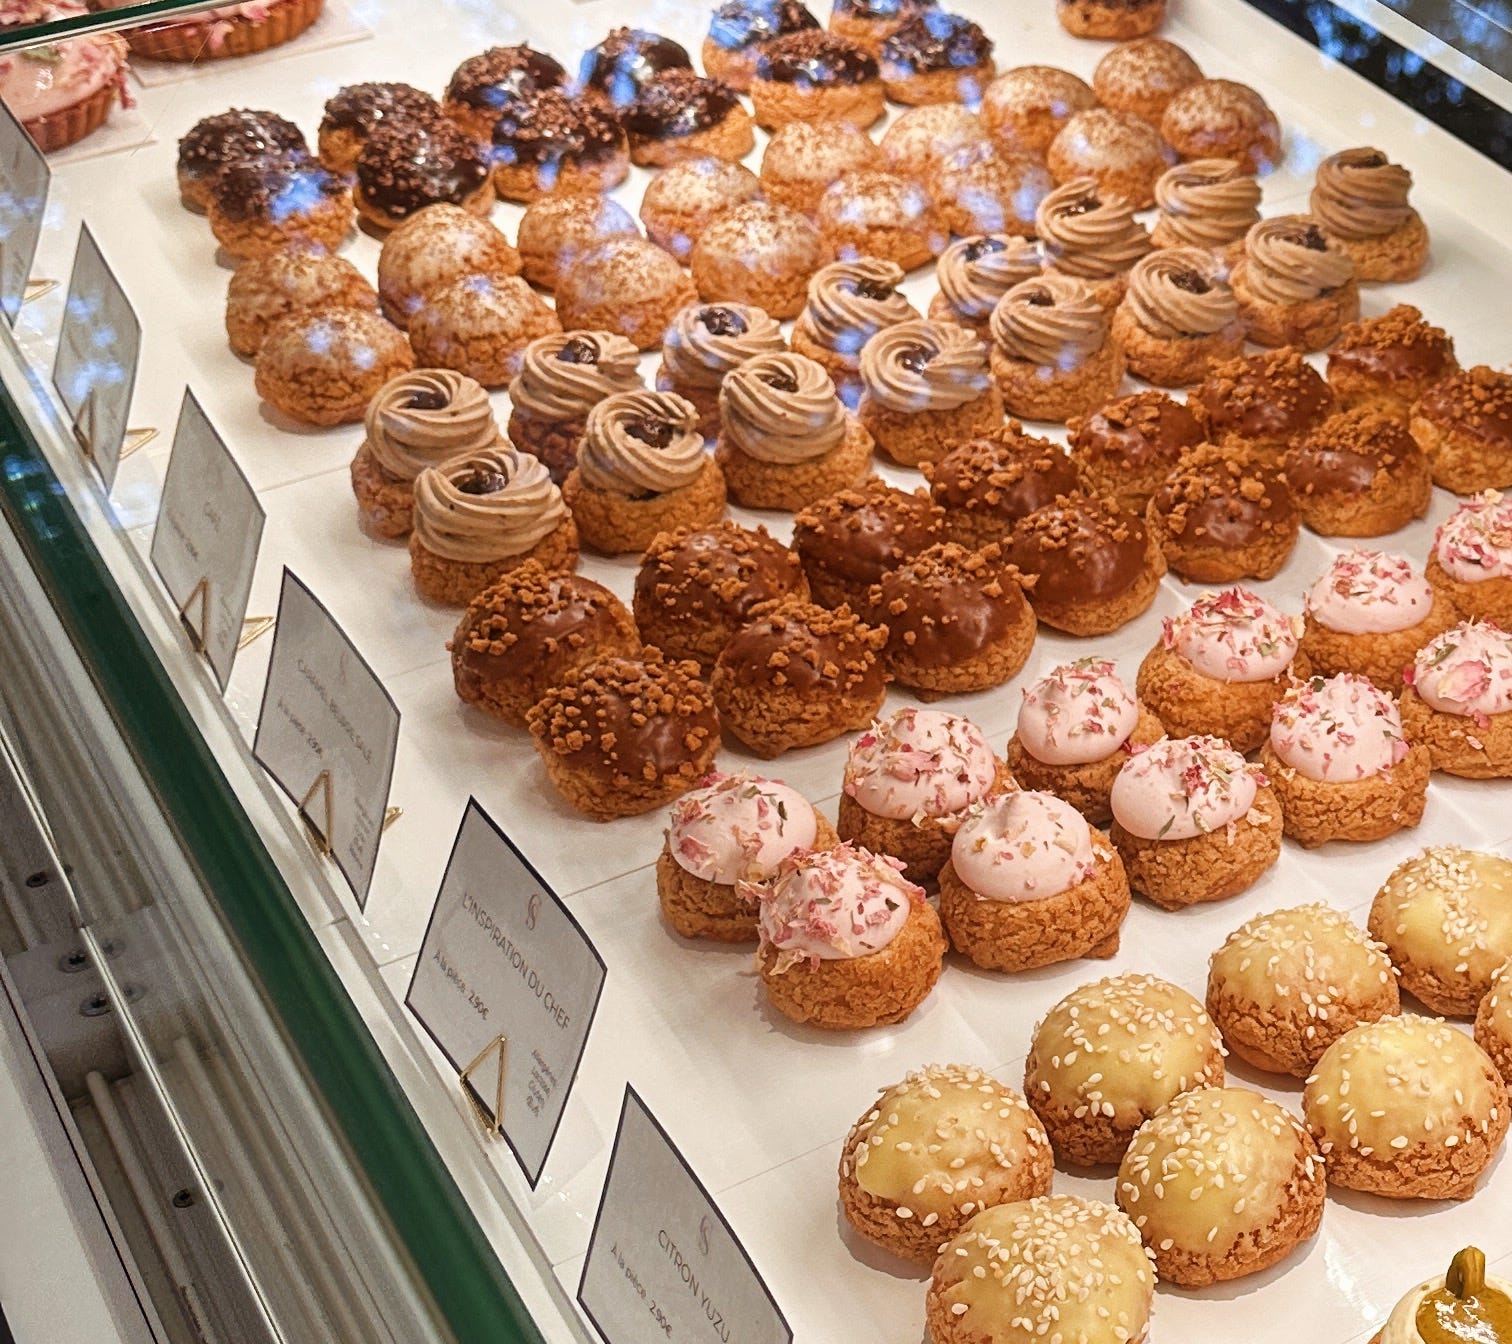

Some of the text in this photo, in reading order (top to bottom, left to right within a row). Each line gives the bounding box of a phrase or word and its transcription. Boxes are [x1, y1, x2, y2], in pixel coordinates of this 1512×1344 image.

[462, 892, 570, 1029] L'INSPIRATION DU CHEF
[649, 1300, 672, 1338] 2.90€
[658, 1229, 730, 1343] CITRON YUZU
